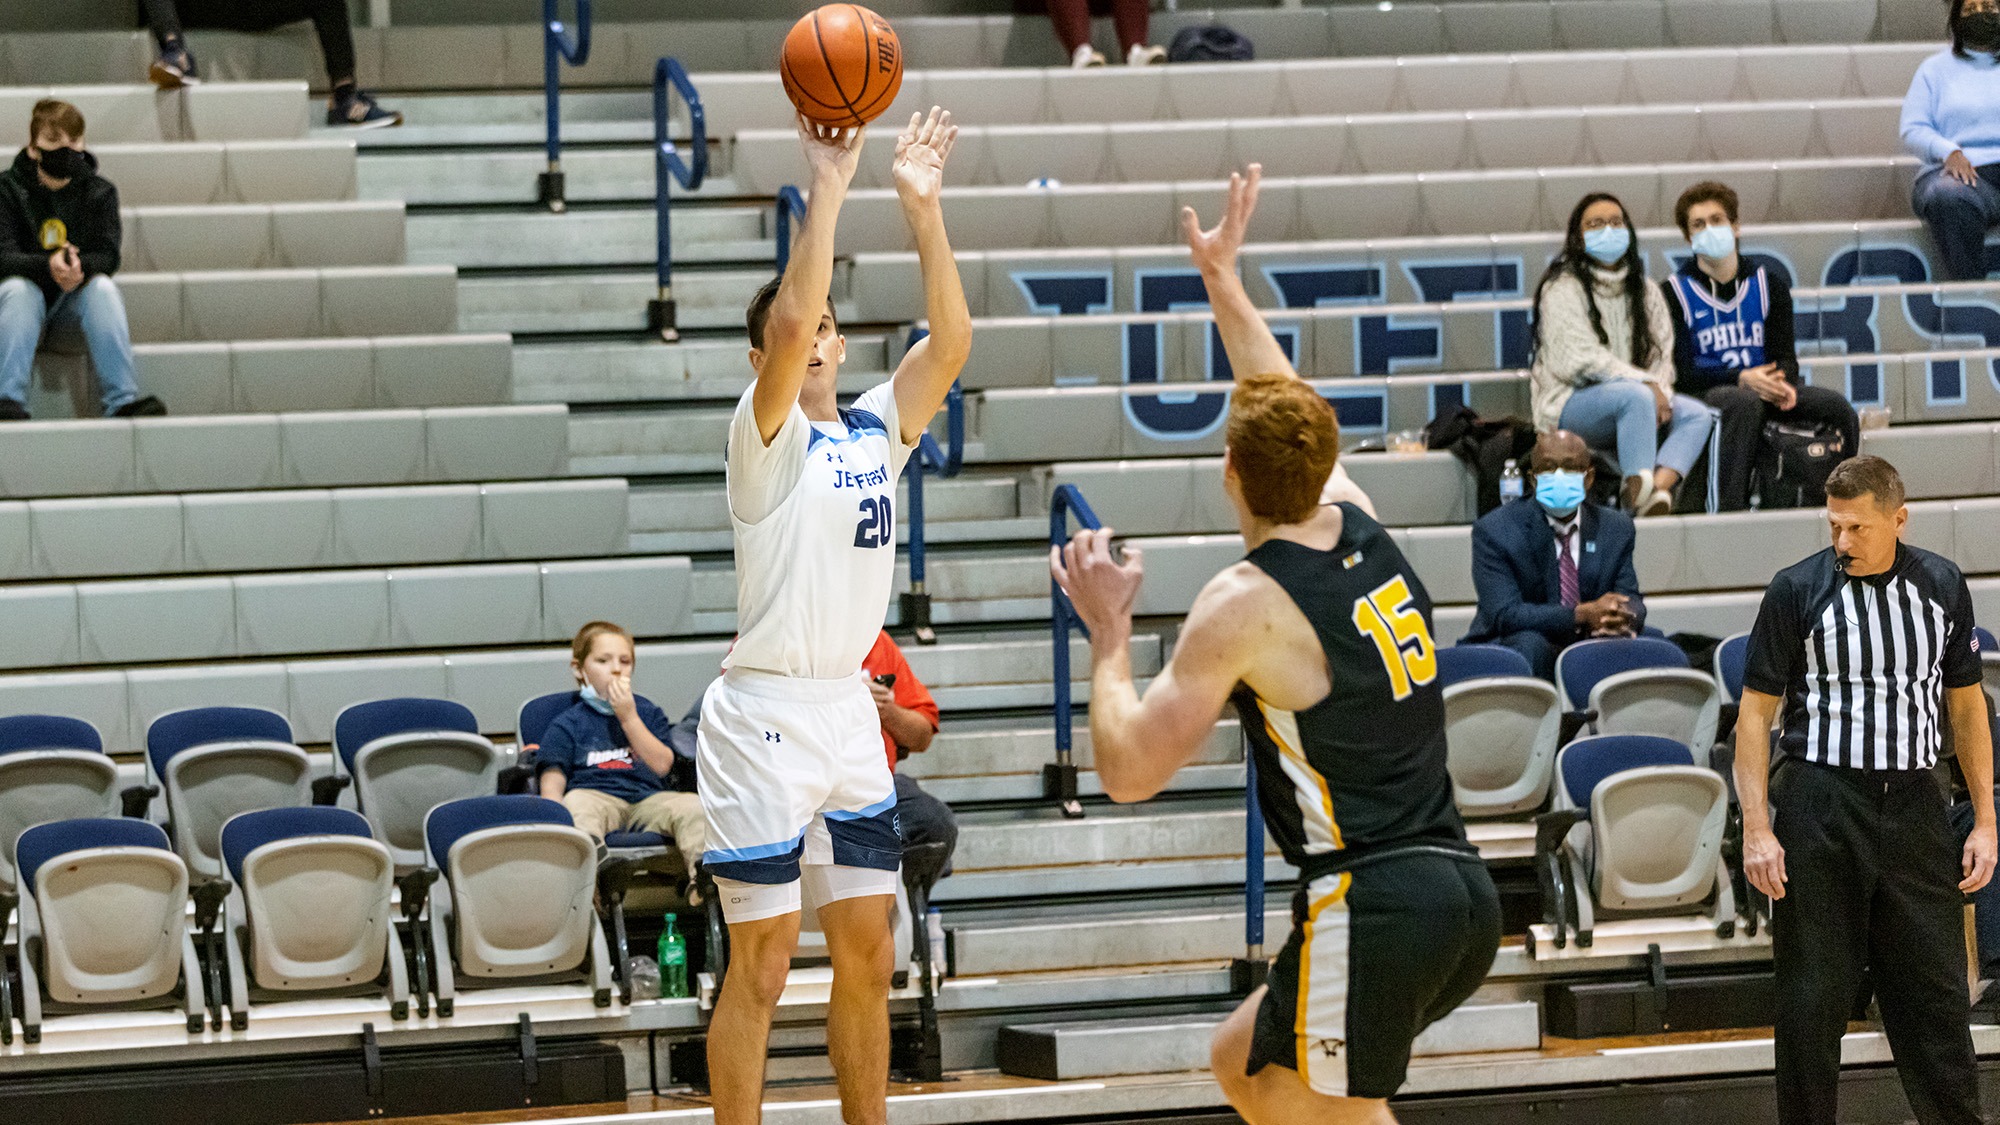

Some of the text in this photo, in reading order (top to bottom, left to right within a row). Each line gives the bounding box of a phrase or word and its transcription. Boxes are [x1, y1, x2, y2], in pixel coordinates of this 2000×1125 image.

[877, 36, 895, 74] THE
[1697, 321, 1764, 354] PHILA
[853, 494, 892, 549] 20
[1351, 573, 1437, 702] 15
